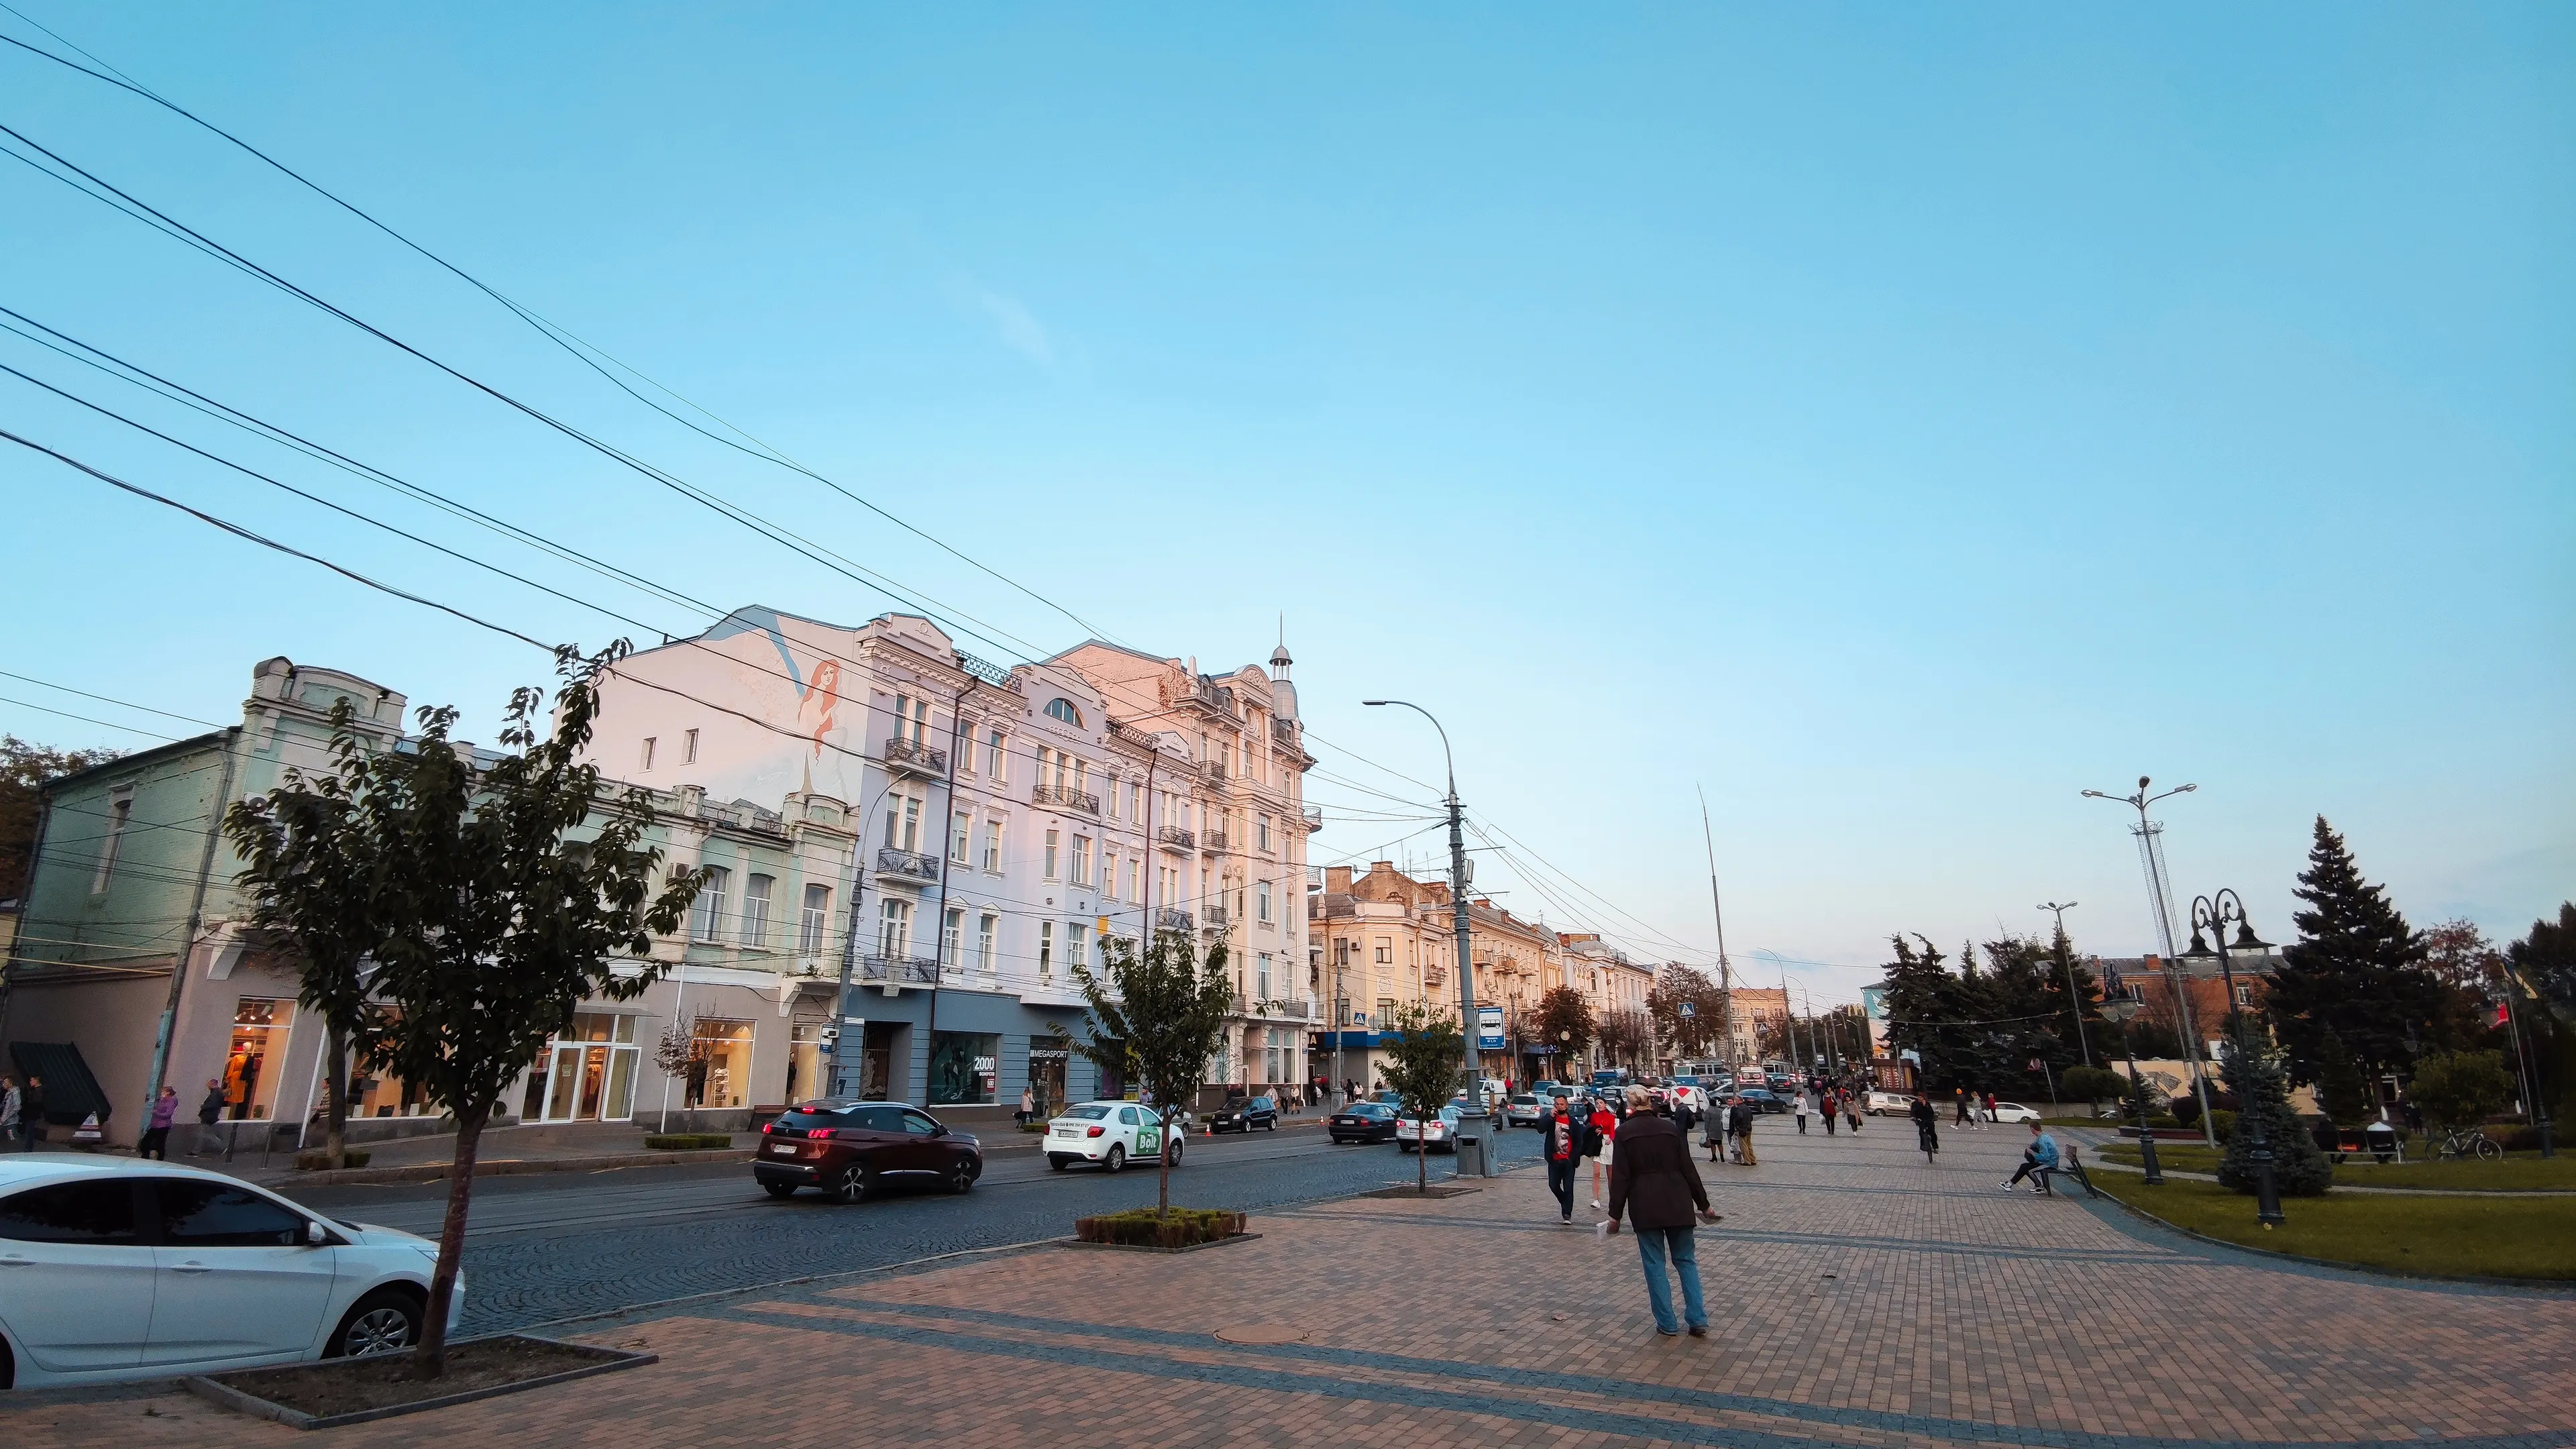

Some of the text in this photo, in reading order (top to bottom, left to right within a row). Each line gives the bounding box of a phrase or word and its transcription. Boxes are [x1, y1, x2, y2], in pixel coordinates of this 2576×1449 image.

[1034, 1050, 1068, 1059] MEGASPORT
[974, 1057, 995, 1071] 2000
[1139, 1134, 1157, 1150] Bolt
